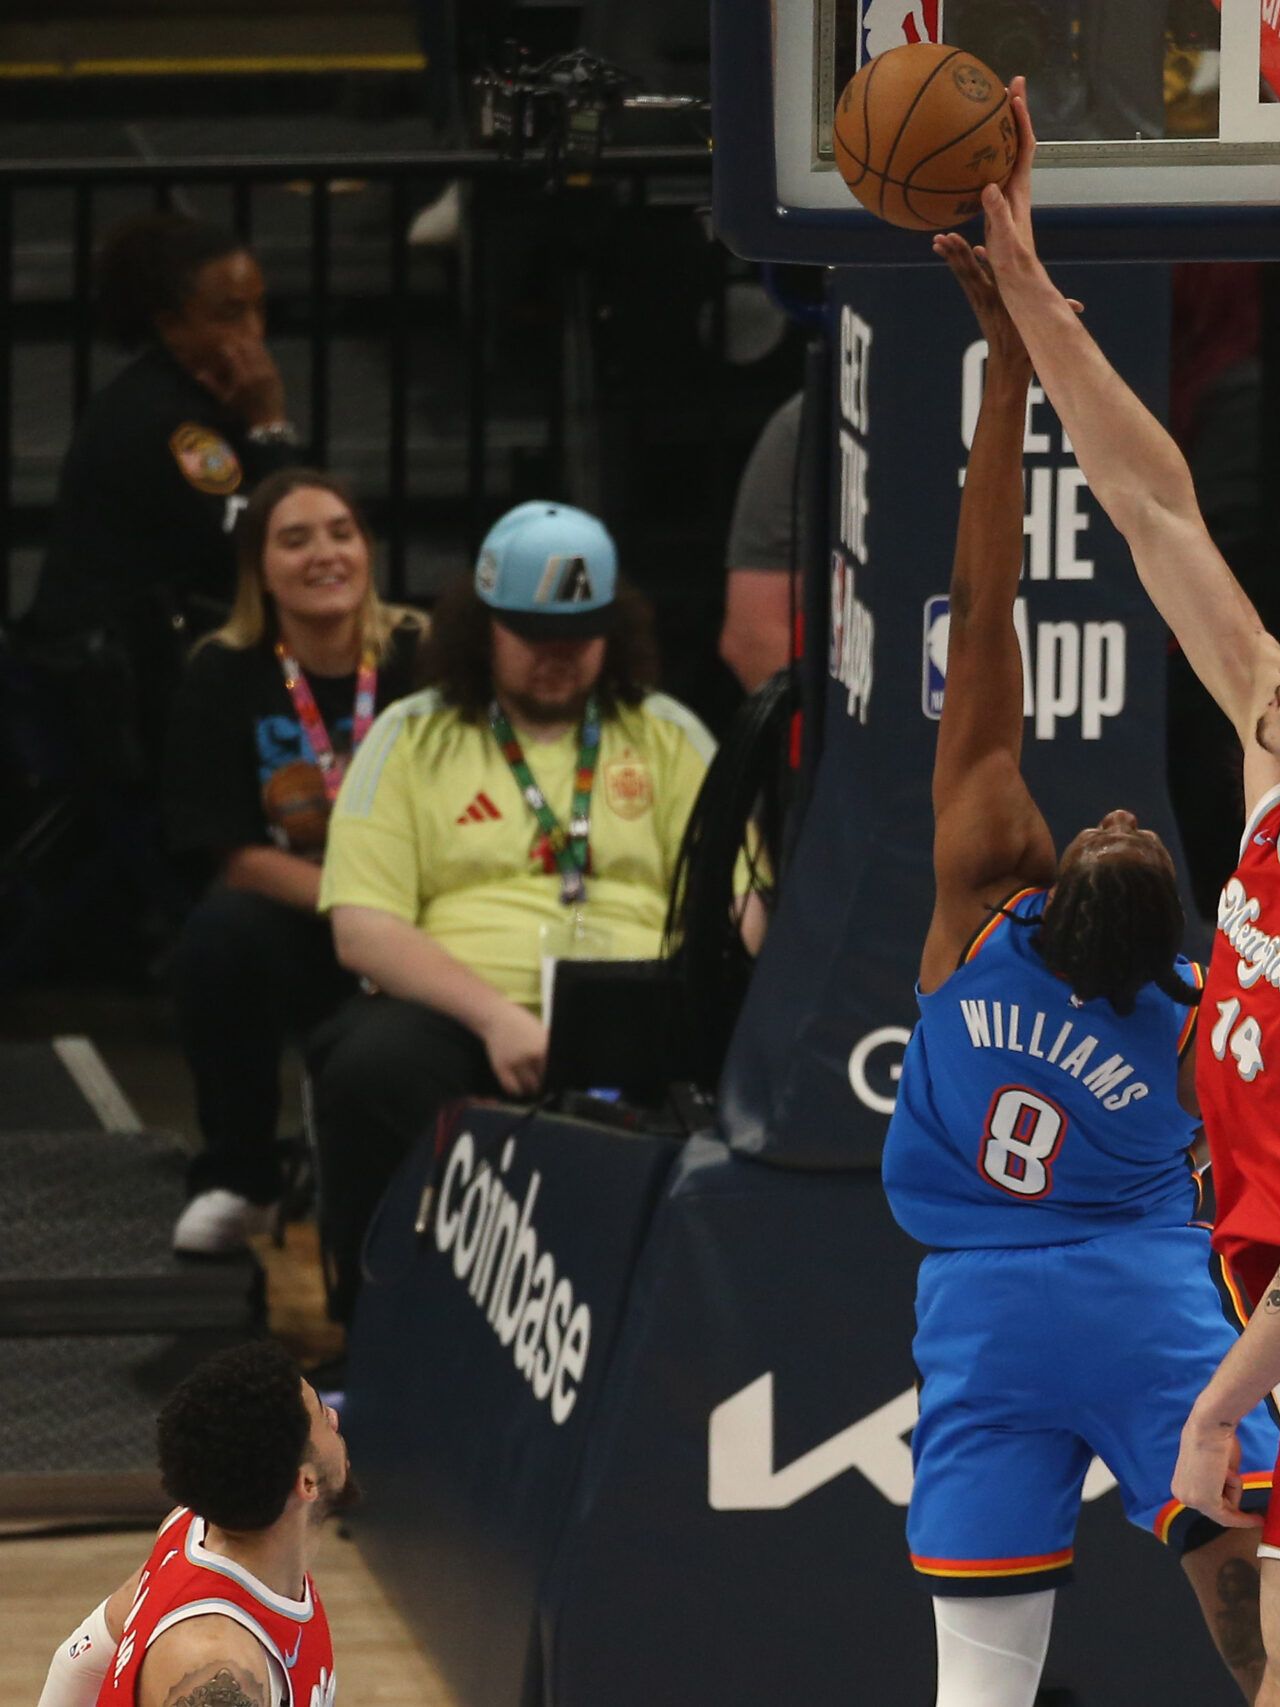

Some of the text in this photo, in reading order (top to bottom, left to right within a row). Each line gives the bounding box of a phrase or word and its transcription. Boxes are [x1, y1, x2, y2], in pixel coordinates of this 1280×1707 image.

[960, 999, 1149, 1112] WILLIAMS
[1211, 997, 1264, 1082] 14
[977, 1083, 1069, 1201] 8
[435, 1130, 592, 1426] coinbase
